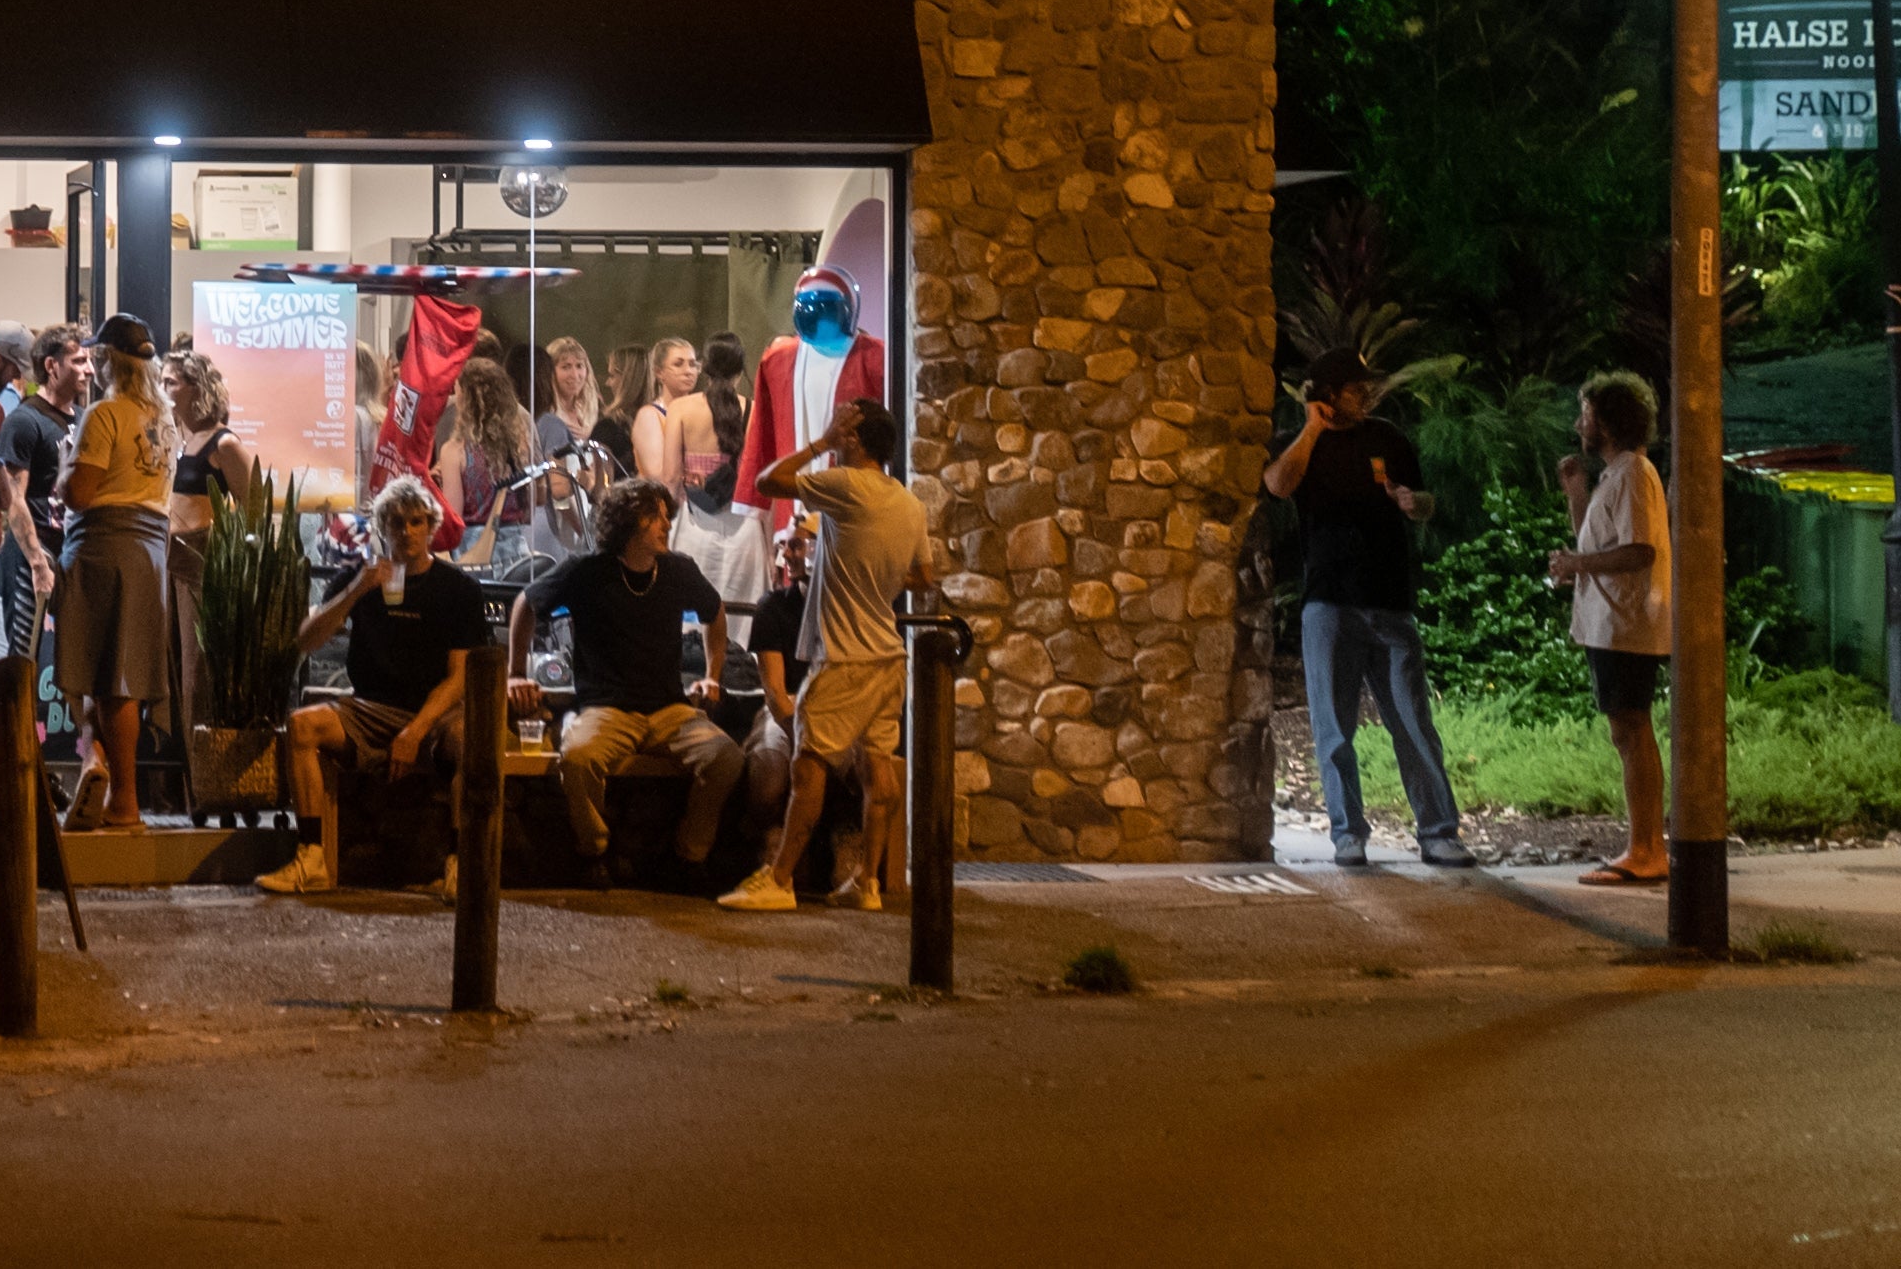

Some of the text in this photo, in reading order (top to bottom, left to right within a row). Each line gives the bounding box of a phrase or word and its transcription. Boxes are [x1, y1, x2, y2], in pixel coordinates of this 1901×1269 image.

[1733, 19, 1849, 49] HALSE
[1776, 91, 1877, 117] SAND
[206, 291, 341, 327] WELCOME
[212, 315, 348, 349] To SUMMER
